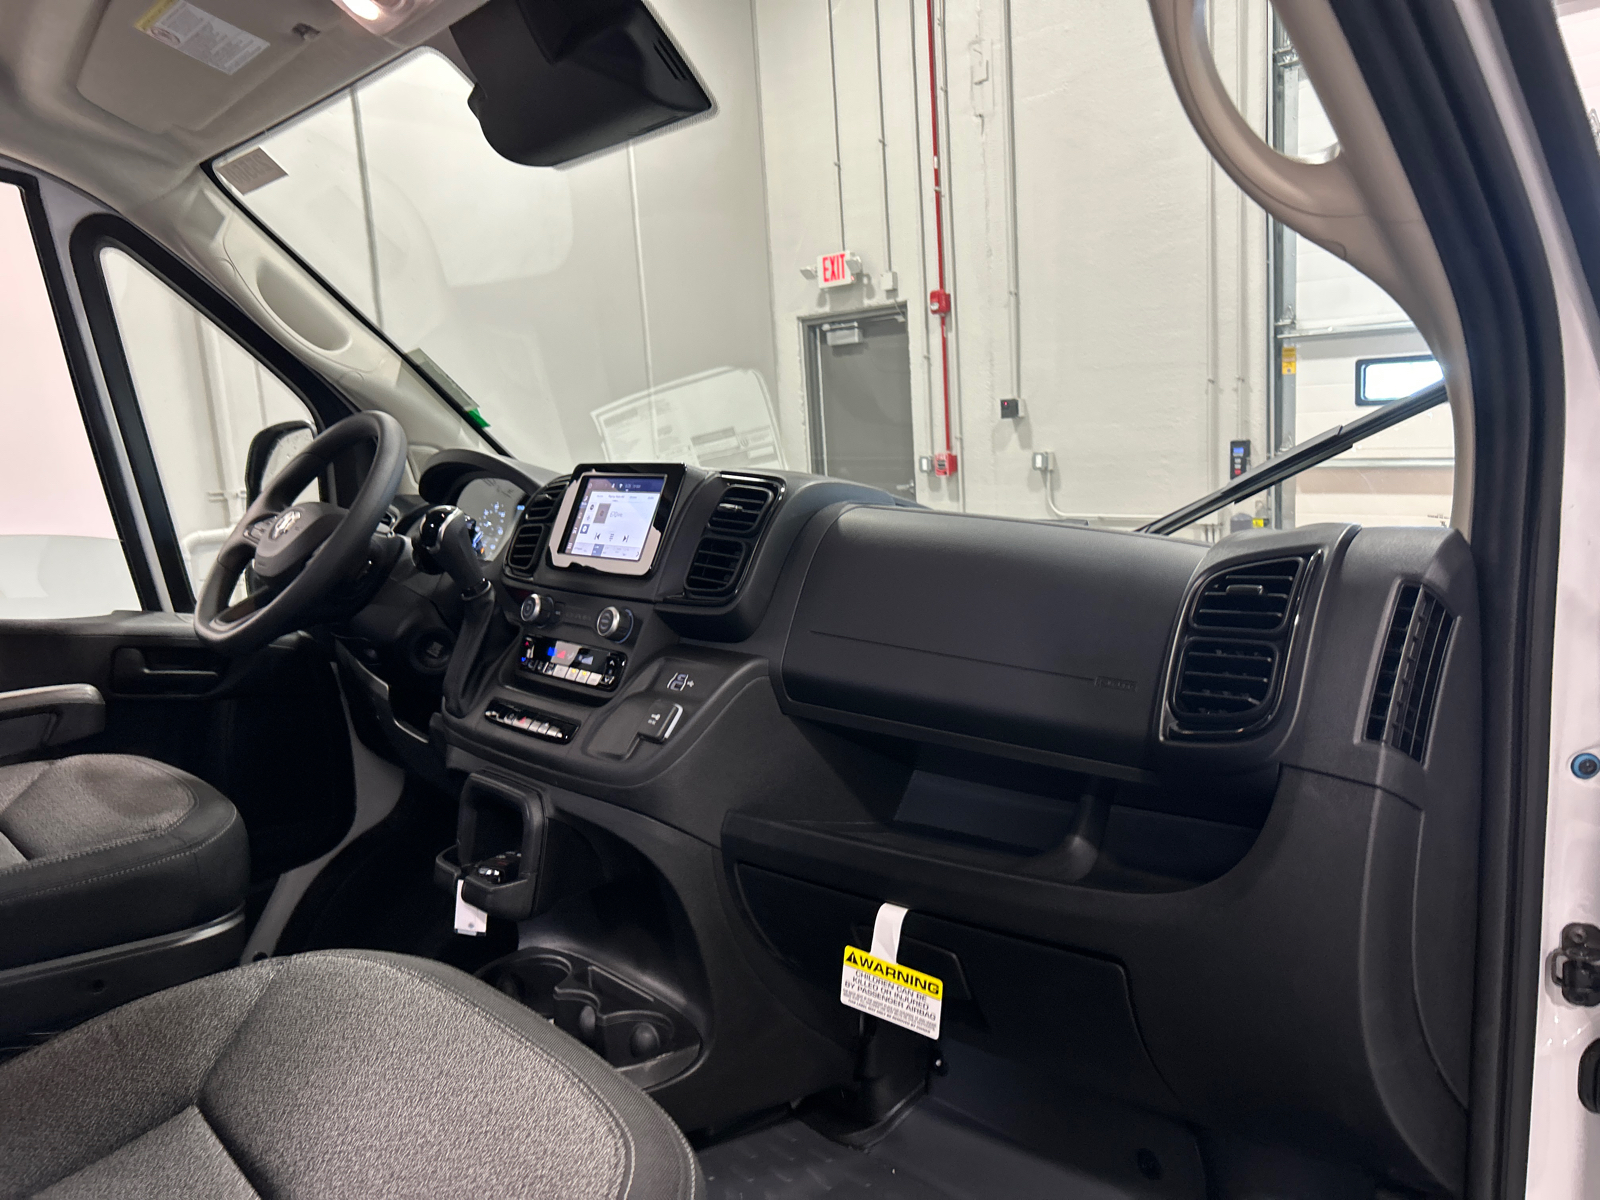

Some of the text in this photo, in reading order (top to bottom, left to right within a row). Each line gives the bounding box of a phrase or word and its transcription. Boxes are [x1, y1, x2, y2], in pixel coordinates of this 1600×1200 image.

[822, 252, 846, 283] EXIT
[852, 975, 928, 1011] KILLED OR INJURED
[855, 969, 927, 1002] CHILDREN CAN BE
[859, 955, 940, 995] WARNING
[844, 980, 855, 990] BY
[857, 985, 903, 1008] PASSENGER
[905, 1003, 936, 1021] AIRBAG
